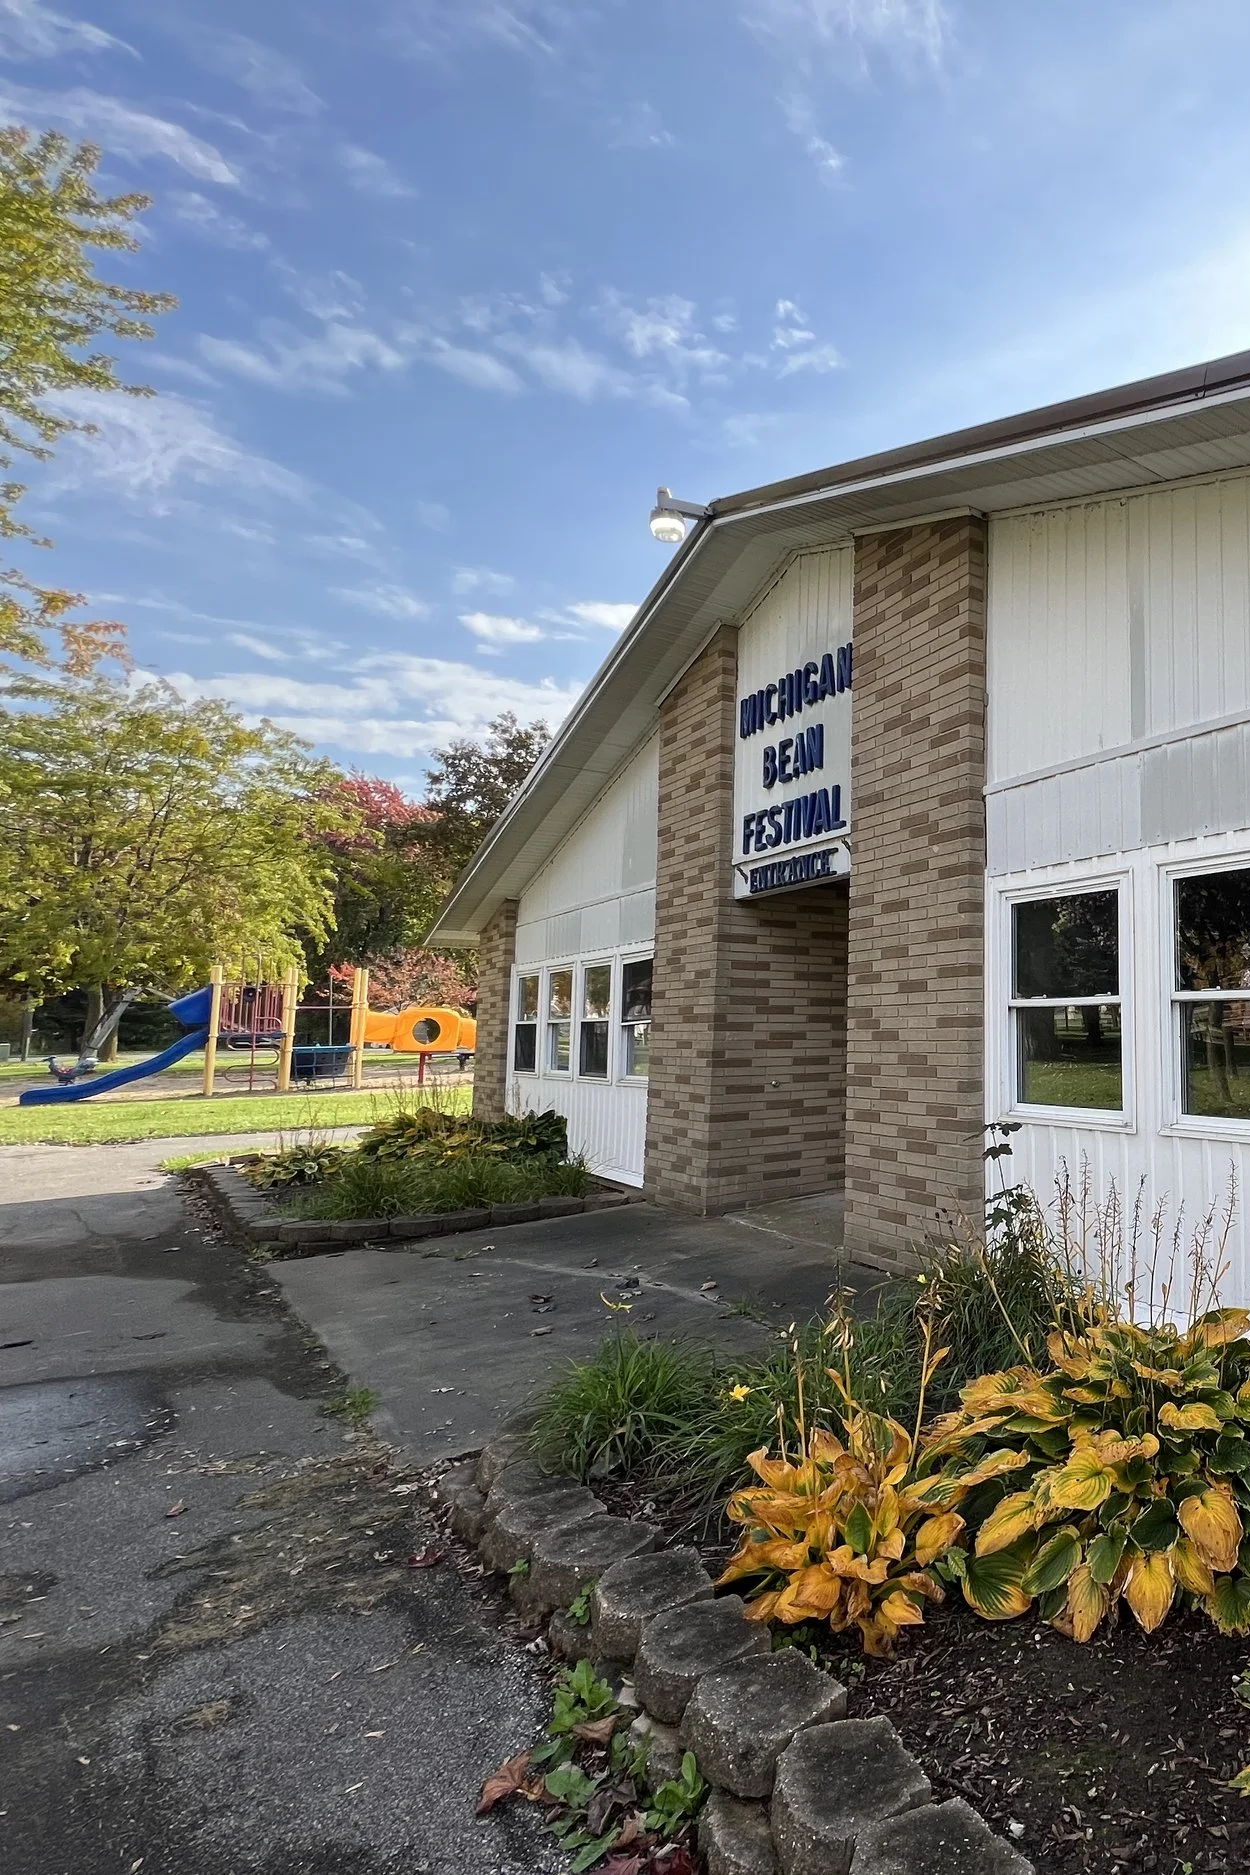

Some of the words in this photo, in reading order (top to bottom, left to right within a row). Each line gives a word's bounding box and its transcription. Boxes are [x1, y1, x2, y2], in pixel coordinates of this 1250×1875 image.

[740, 642, 852, 739] MICHIGAN
[762, 723, 824, 789] BEAN
[743, 784, 846, 855] FESTIVAL
[749, 847, 838, 893] ENTRANCE
